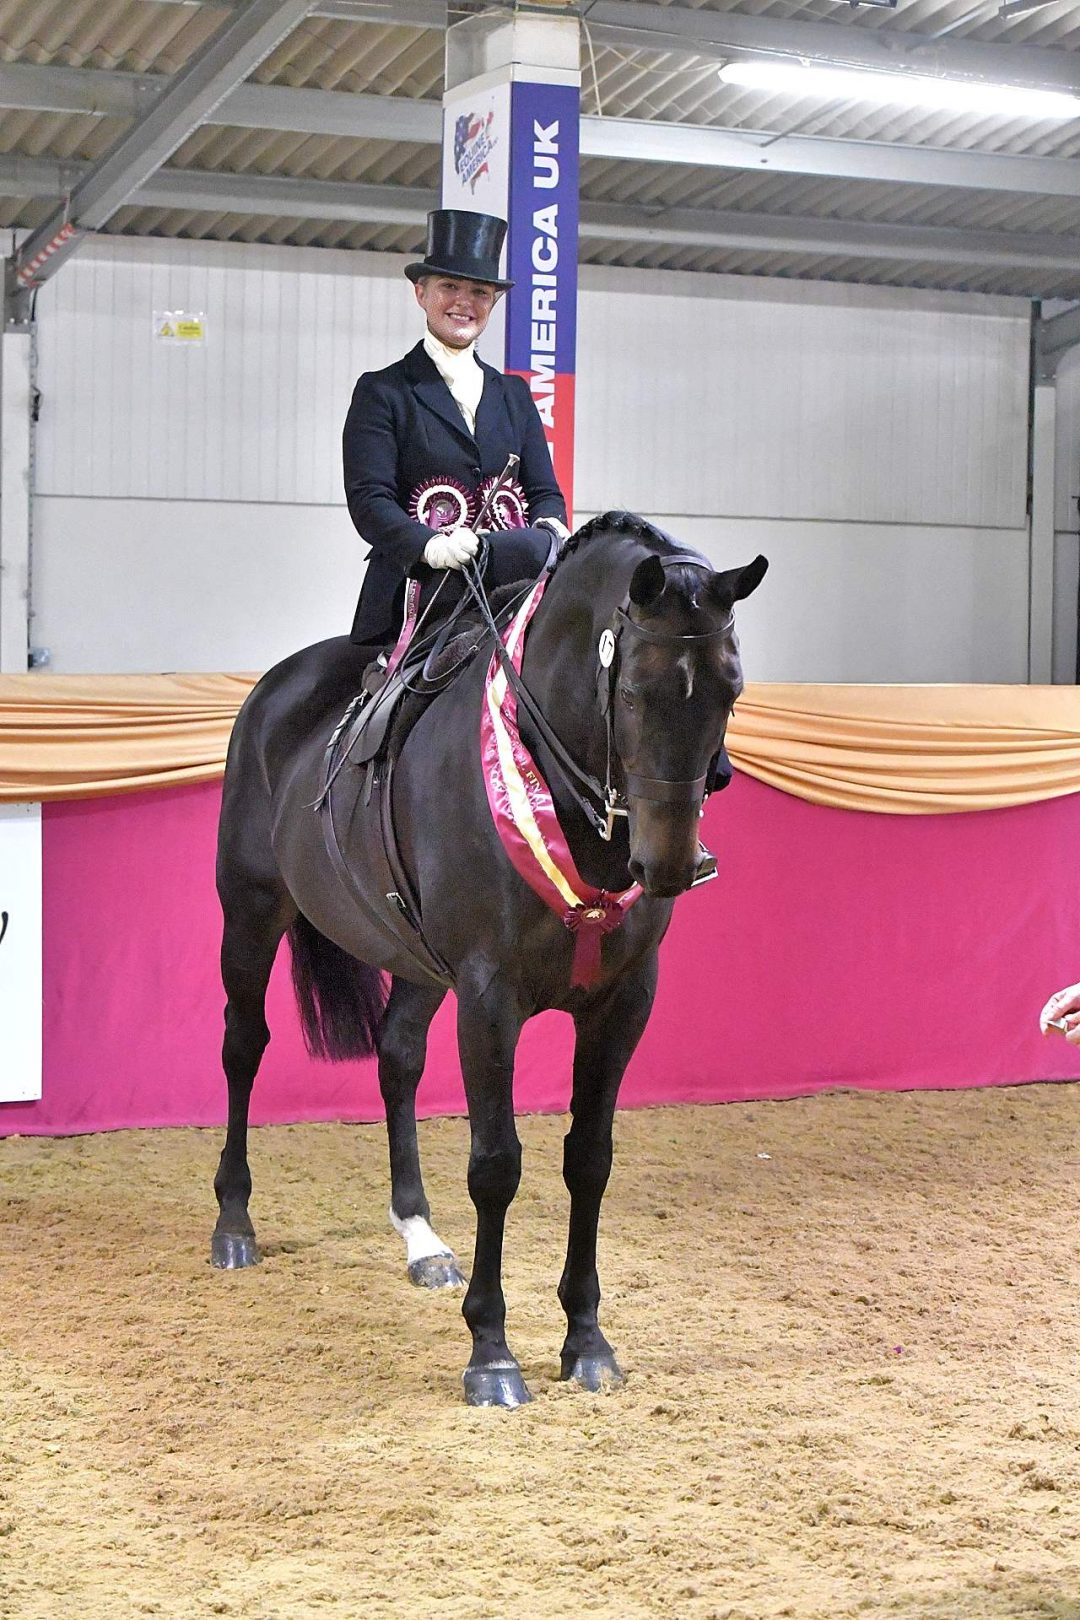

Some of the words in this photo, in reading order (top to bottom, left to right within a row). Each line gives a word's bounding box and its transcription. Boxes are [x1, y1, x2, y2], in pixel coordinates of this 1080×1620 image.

[459, 132, 486, 172] EQUINE
[462, 139, 494, 184] AMERICA
[532, 119, 560, 189] UK
[530, 204, 560, 428] AMERICA
[601, 634, 613, 660] 17
